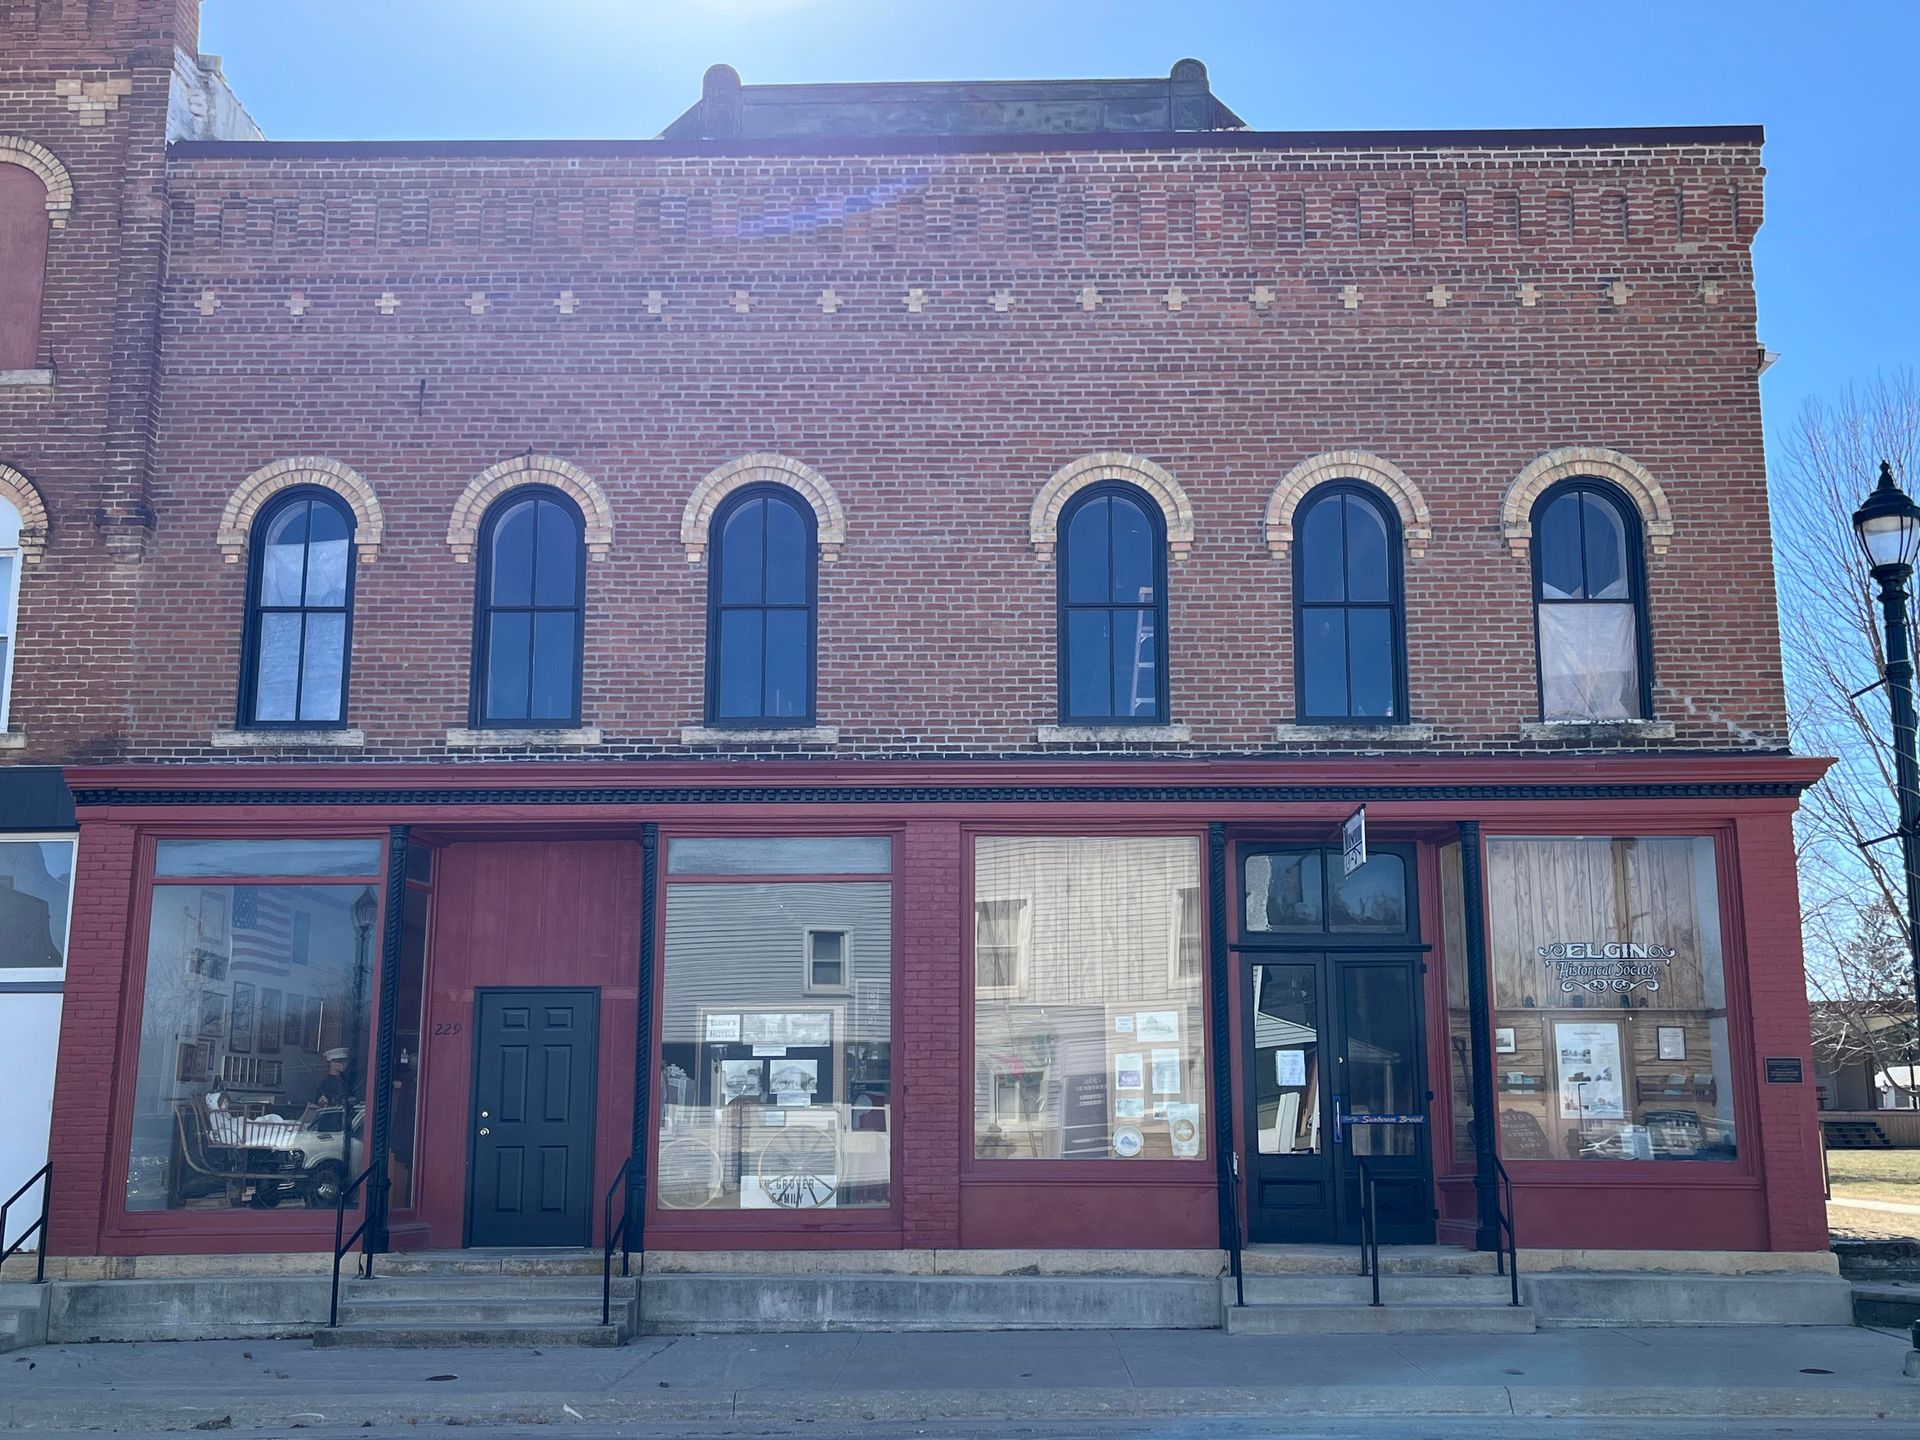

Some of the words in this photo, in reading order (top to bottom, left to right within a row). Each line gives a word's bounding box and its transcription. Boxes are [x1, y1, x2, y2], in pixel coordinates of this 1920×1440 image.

[1564, 943, 1648, 959] ELGIN
[1556, 961, 1613, 979] Historical
[1615, 961, 1660, 980] Society
[435, 1023, 462, 1036] 229
[709, 1029, 737, 1038] HOTELS
